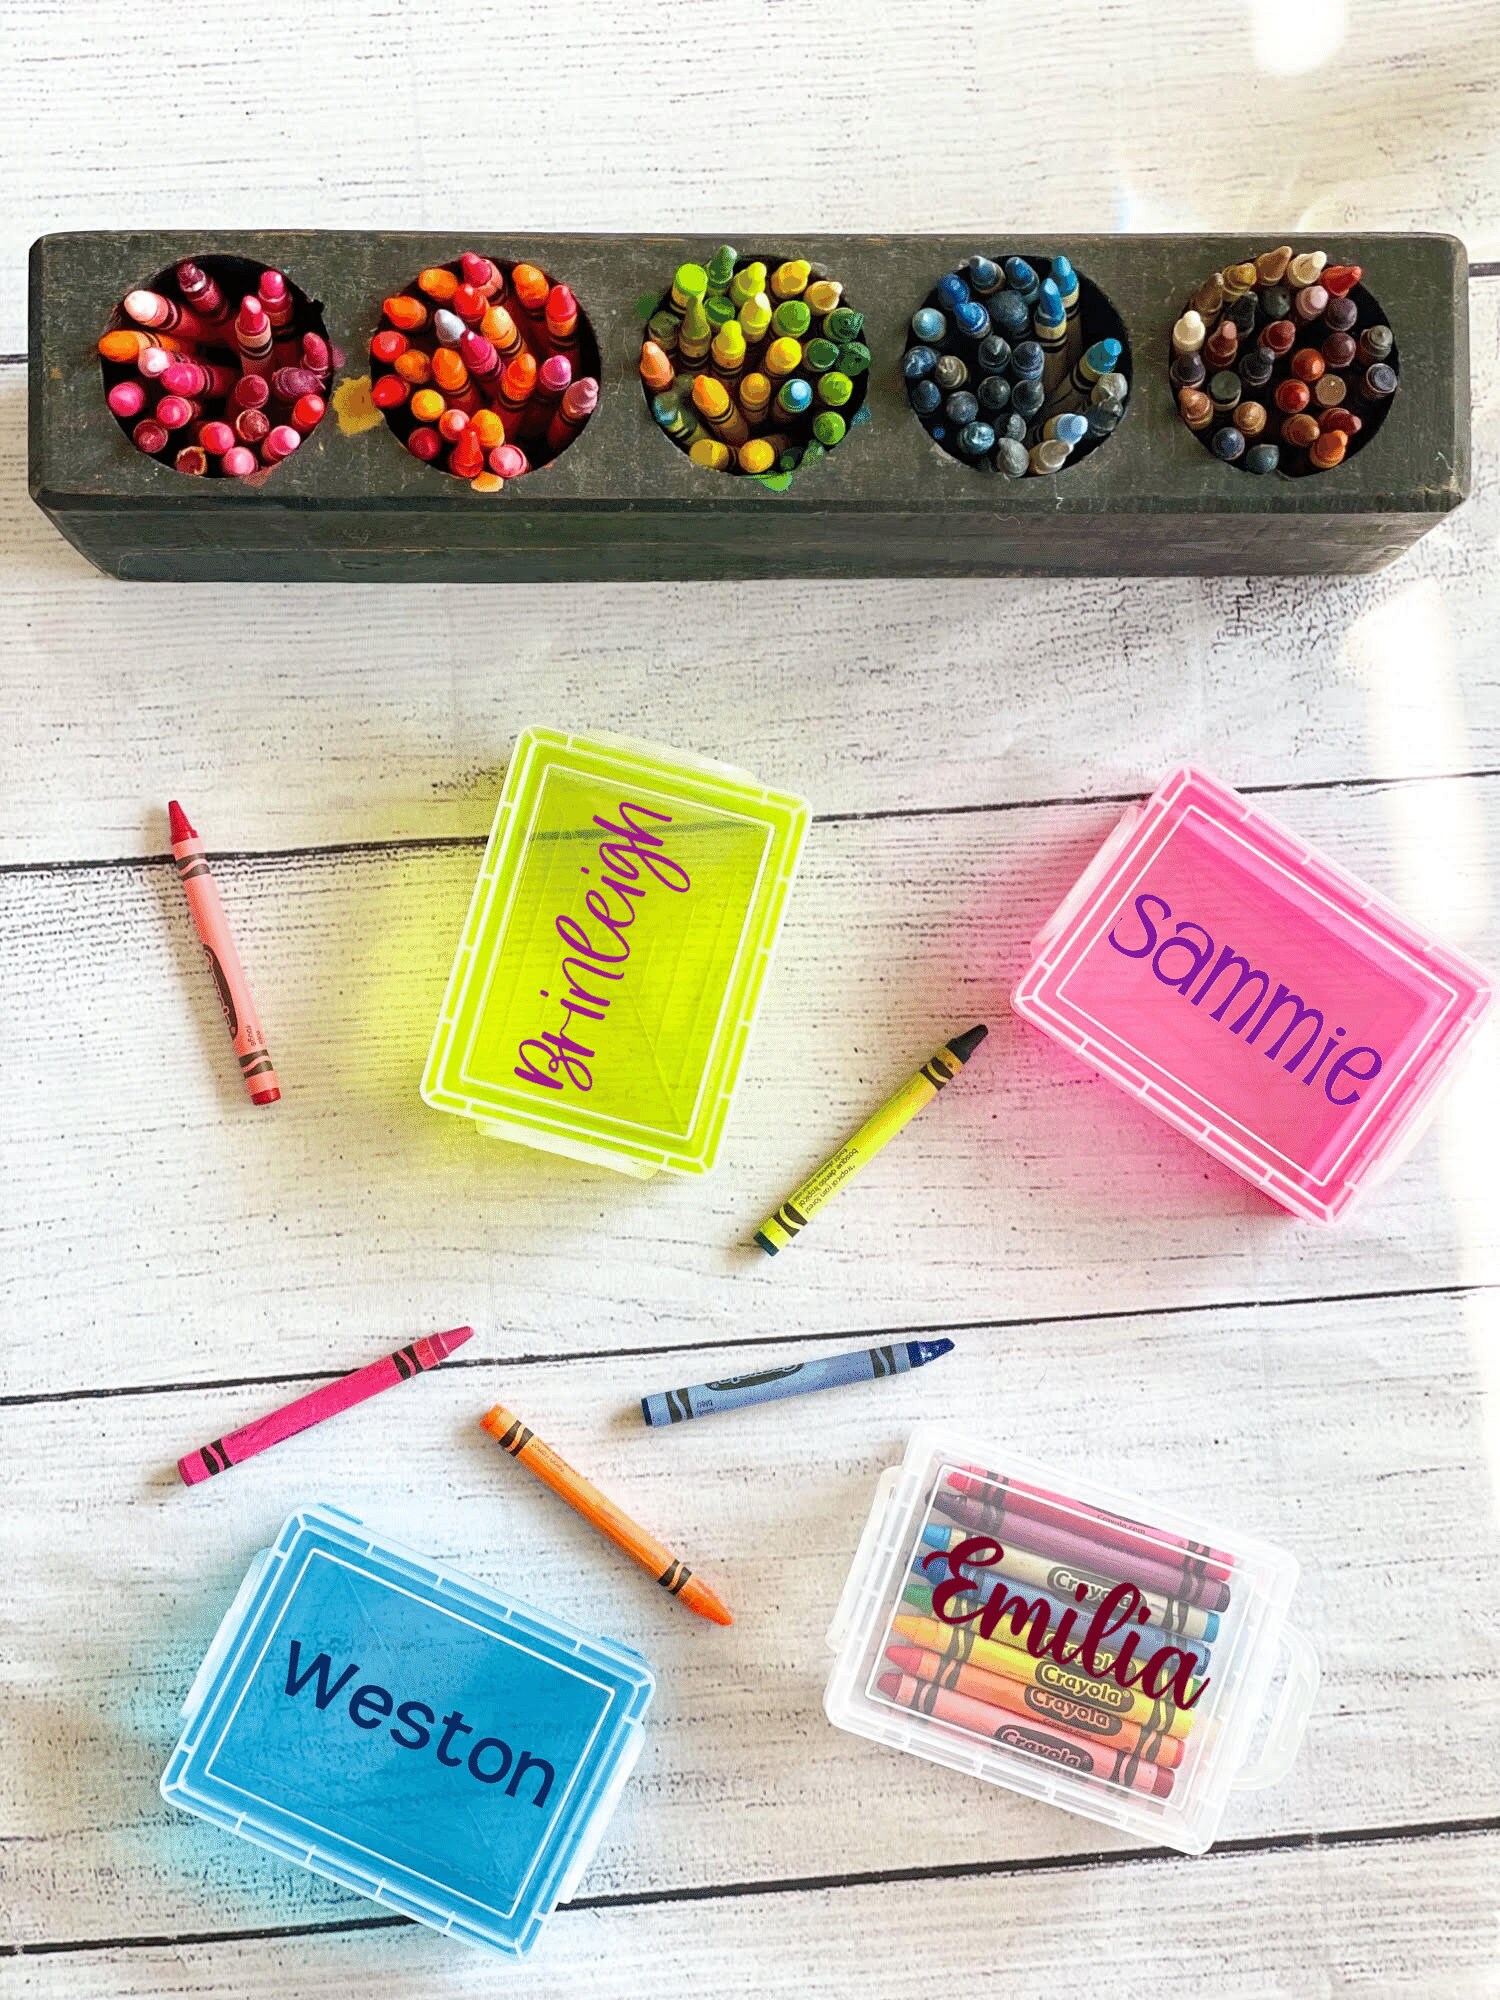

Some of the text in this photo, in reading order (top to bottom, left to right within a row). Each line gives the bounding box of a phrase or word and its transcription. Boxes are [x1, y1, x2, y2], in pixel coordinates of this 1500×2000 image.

[514, 802, 691, 1091] Brinleigh
[1108, 894, 1383, 1105] Sammie
[922, 1536, 1210, 1710] Emilia
[1031, 1688, 1110, 1728] Crayola
[285, 1640, 555, 1808] Weston
[1001, 1729, 1081, 1768] Crayola
